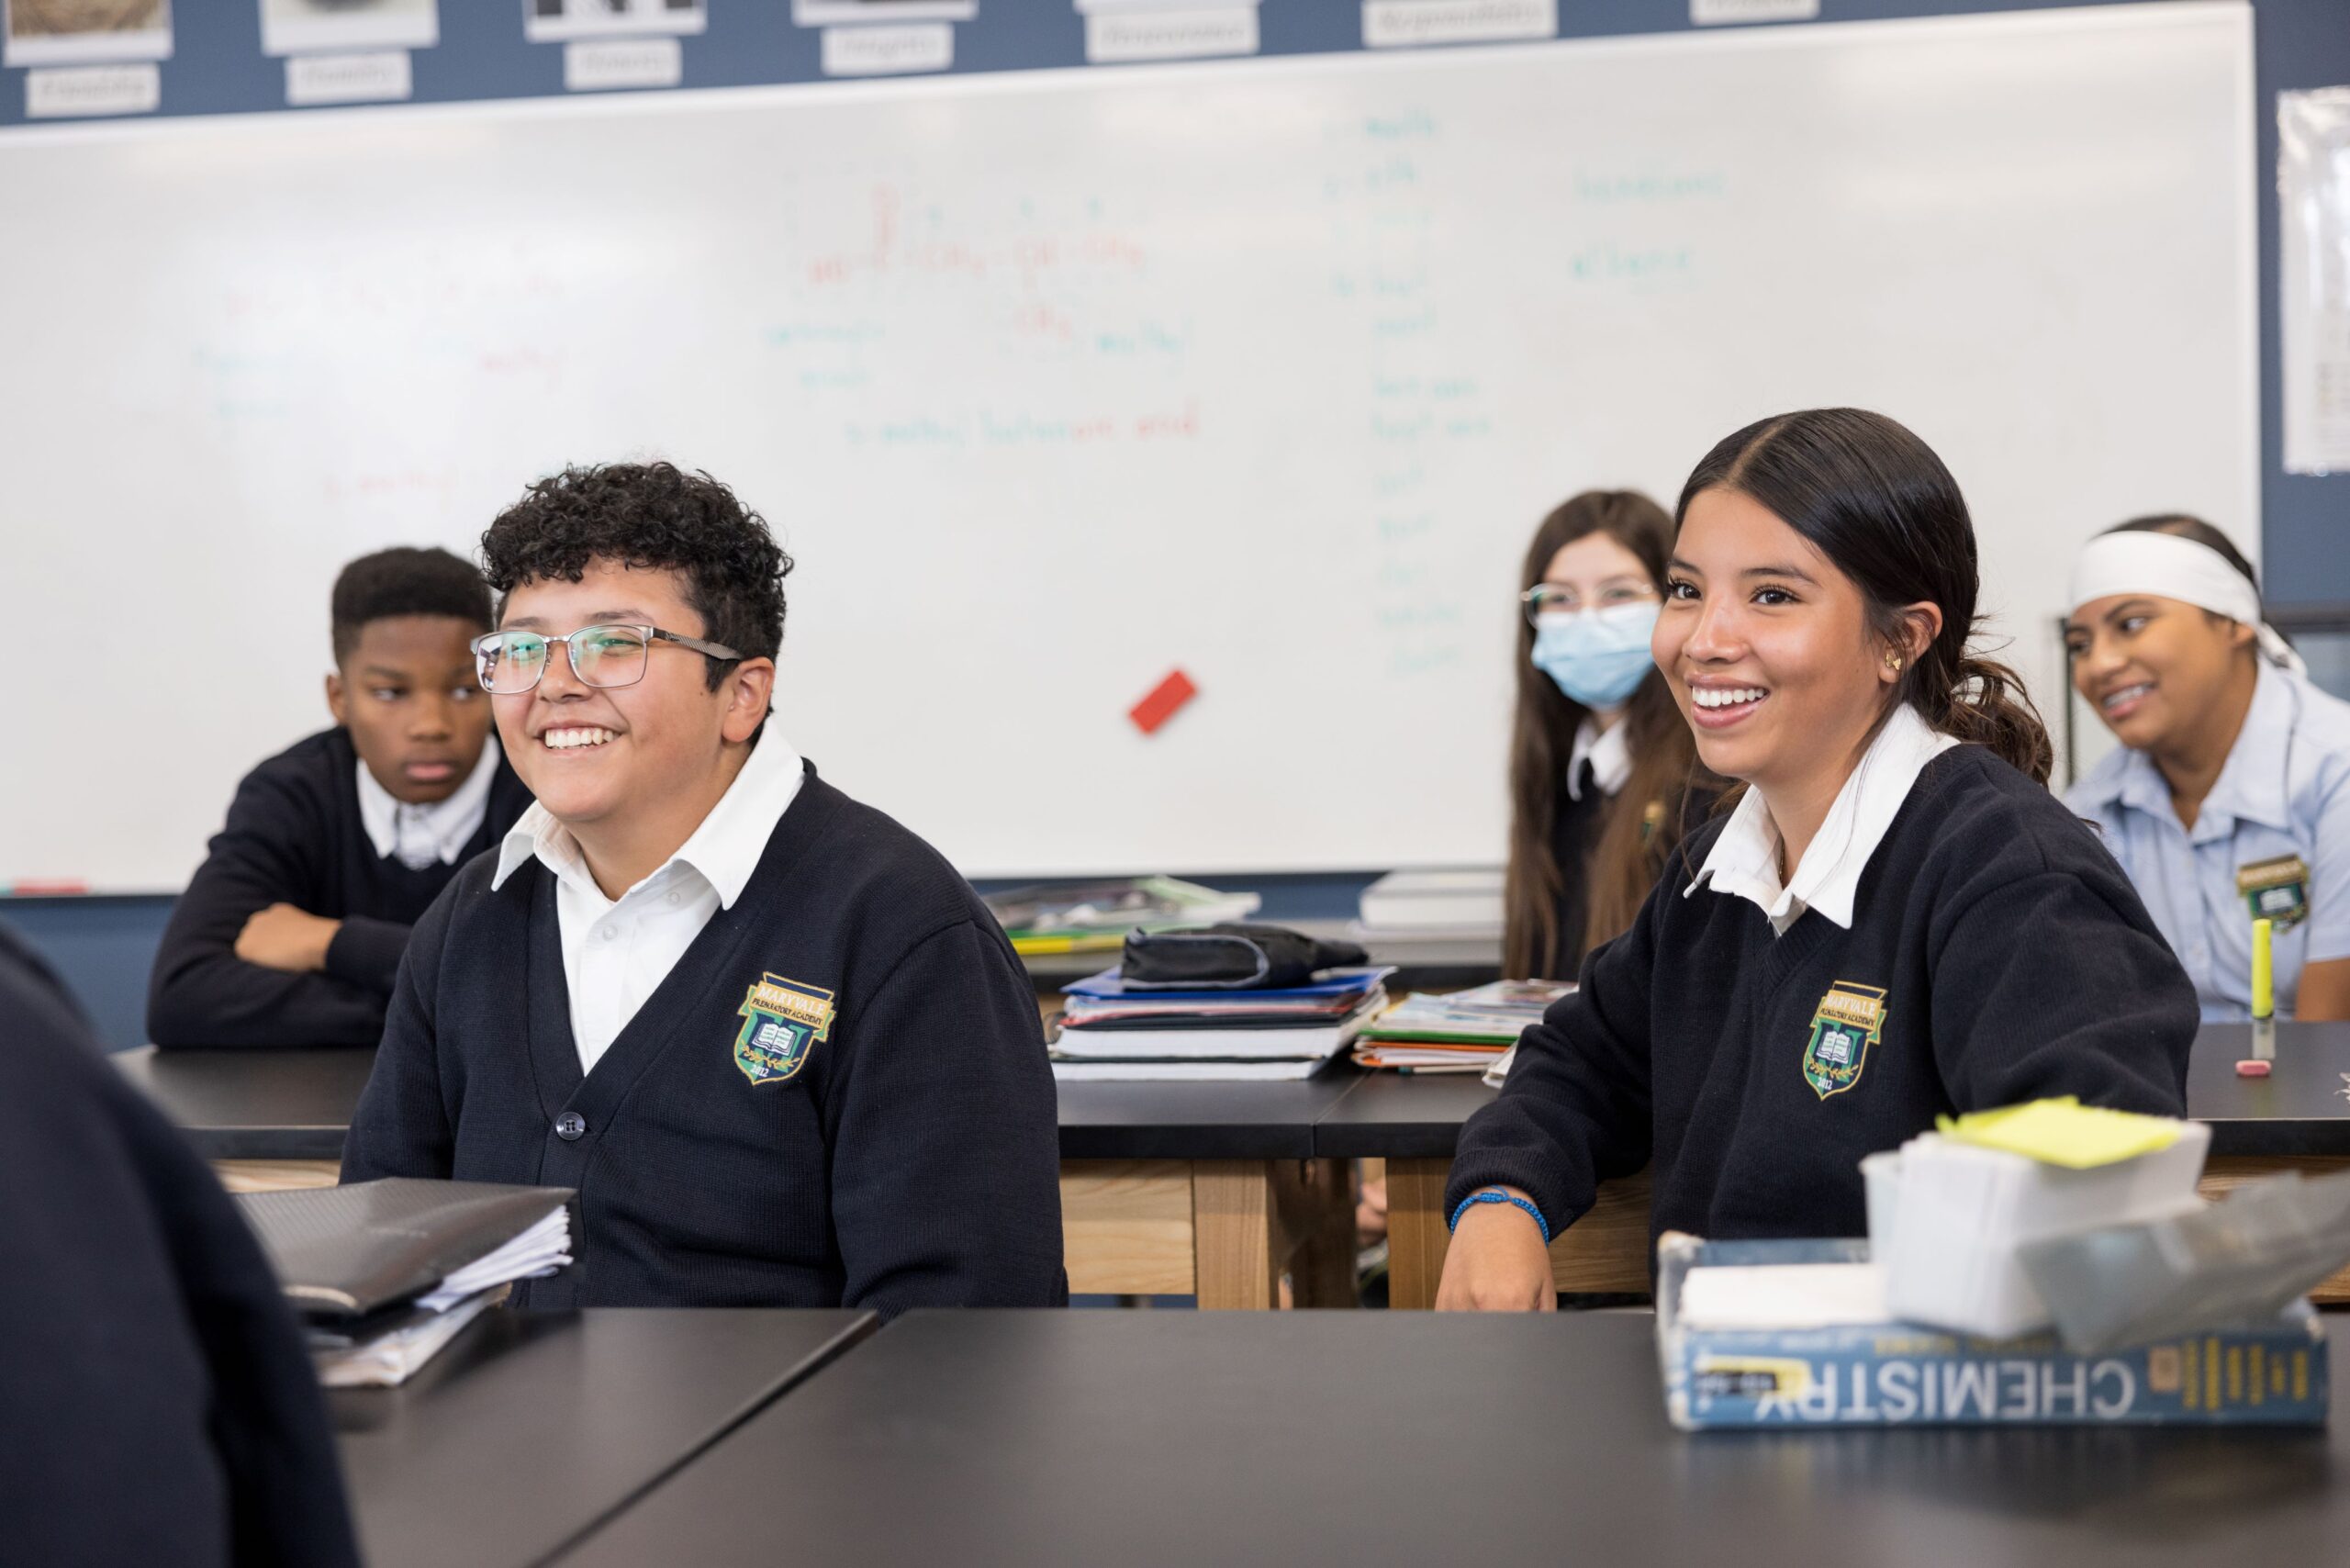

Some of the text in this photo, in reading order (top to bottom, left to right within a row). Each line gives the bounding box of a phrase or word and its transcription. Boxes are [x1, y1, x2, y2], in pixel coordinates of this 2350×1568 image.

[752, 998, 823, 1025] PREPARATORY ACADEMY
[758, 986, 826, 1015] MARYVALE
[1827, 993, 1876, 1016] MARYVALE
[750, 1064, 769, 1078] 2012
[1817, 1077, 1832, 1090] 2012
[1754, 1360, 2136, 1422] CHEMISTRY
